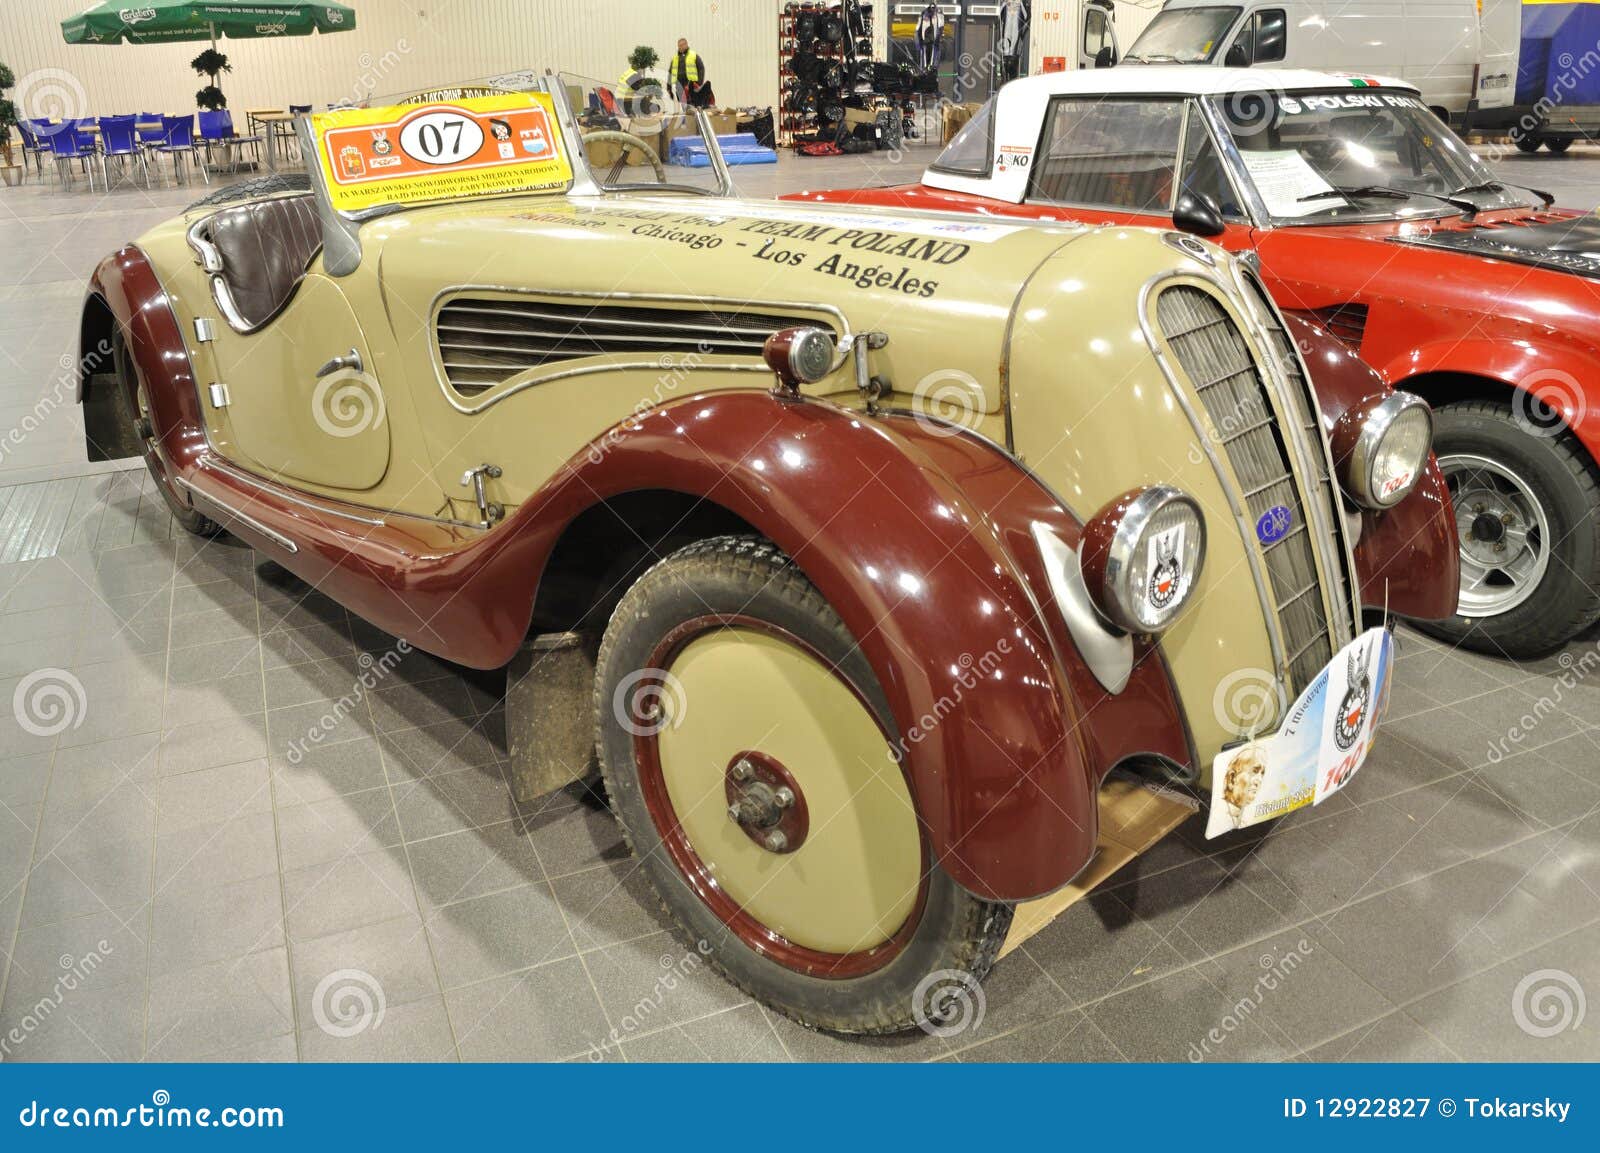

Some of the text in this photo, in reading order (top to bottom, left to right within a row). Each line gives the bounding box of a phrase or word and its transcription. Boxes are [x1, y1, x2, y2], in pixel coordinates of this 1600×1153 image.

[1301, 93, 1385, 111] POLSKI
[419, 120, 465, 157] 07
[631, 222, 723, 250] Chicago
[752, 238, 808, 266] Los
[813, 253, 940, 298] Angeles
[741, 219, 834, 242] TEAM
[827, 229, 971, 266] POLAND
